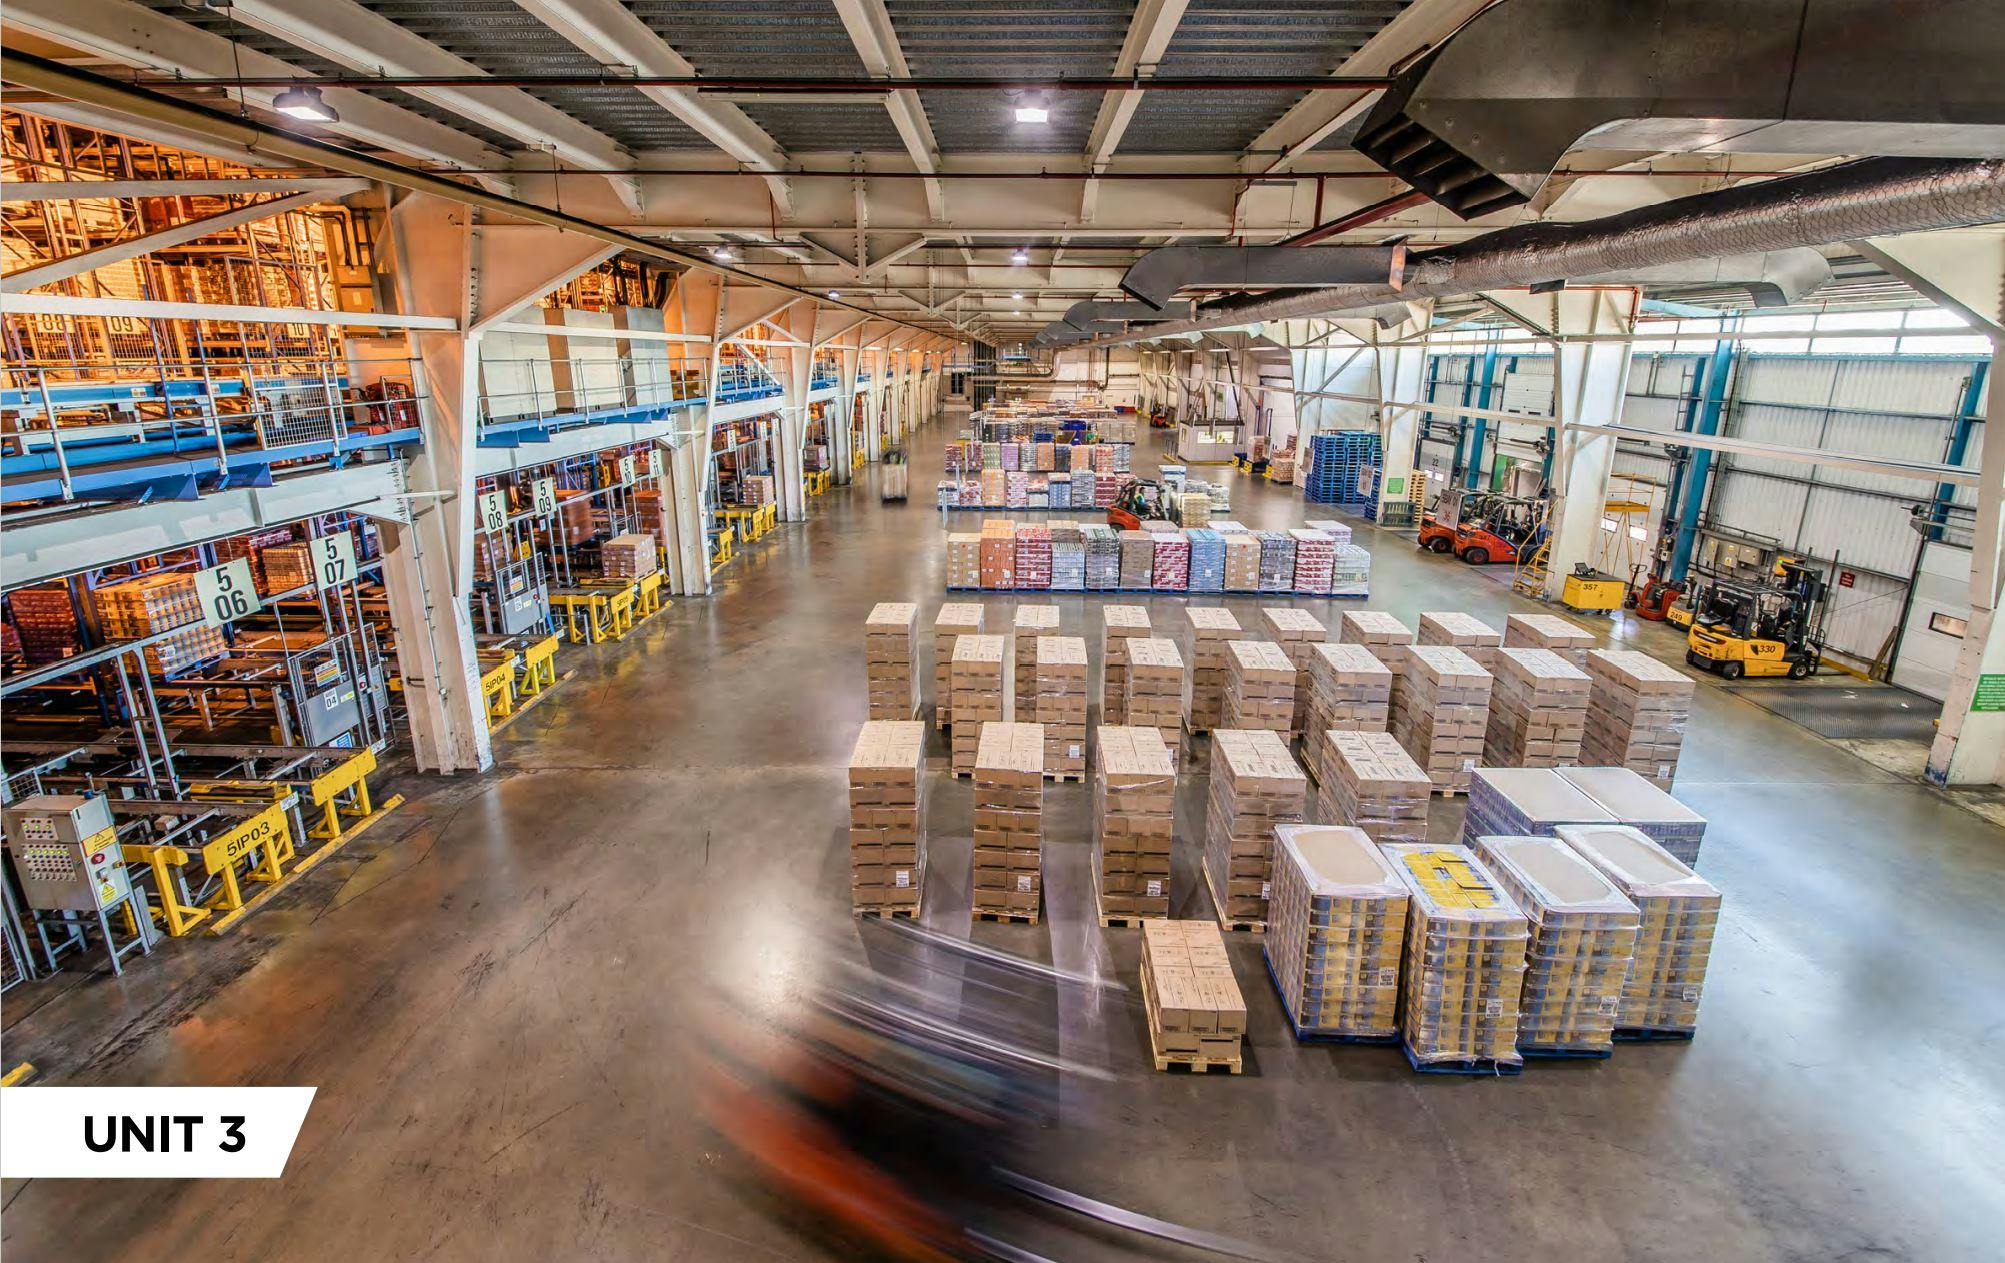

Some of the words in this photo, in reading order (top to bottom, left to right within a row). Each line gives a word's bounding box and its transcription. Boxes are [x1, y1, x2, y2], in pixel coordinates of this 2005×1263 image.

[110, 316, 133, 332] 09
[540, 481, 547, 497] 5
[490, 494, 497, 512] 5
[539, 496, 552, 514] 09
[488, 511, 503, 530] 08
[324, 537, 337, 560] 5
[215, 566, 232, 592] 5
[324, 558, 345, 585] 07
[1583, 583, 1598, 591] 357
[214, 589, 248, 620] 06
[1670, 611, 1682, 621] 249
[1759, 645, 1776, 653] 330
[326, 697, 337, 708] 04
[227, 821, 270, 857] 5IP03
